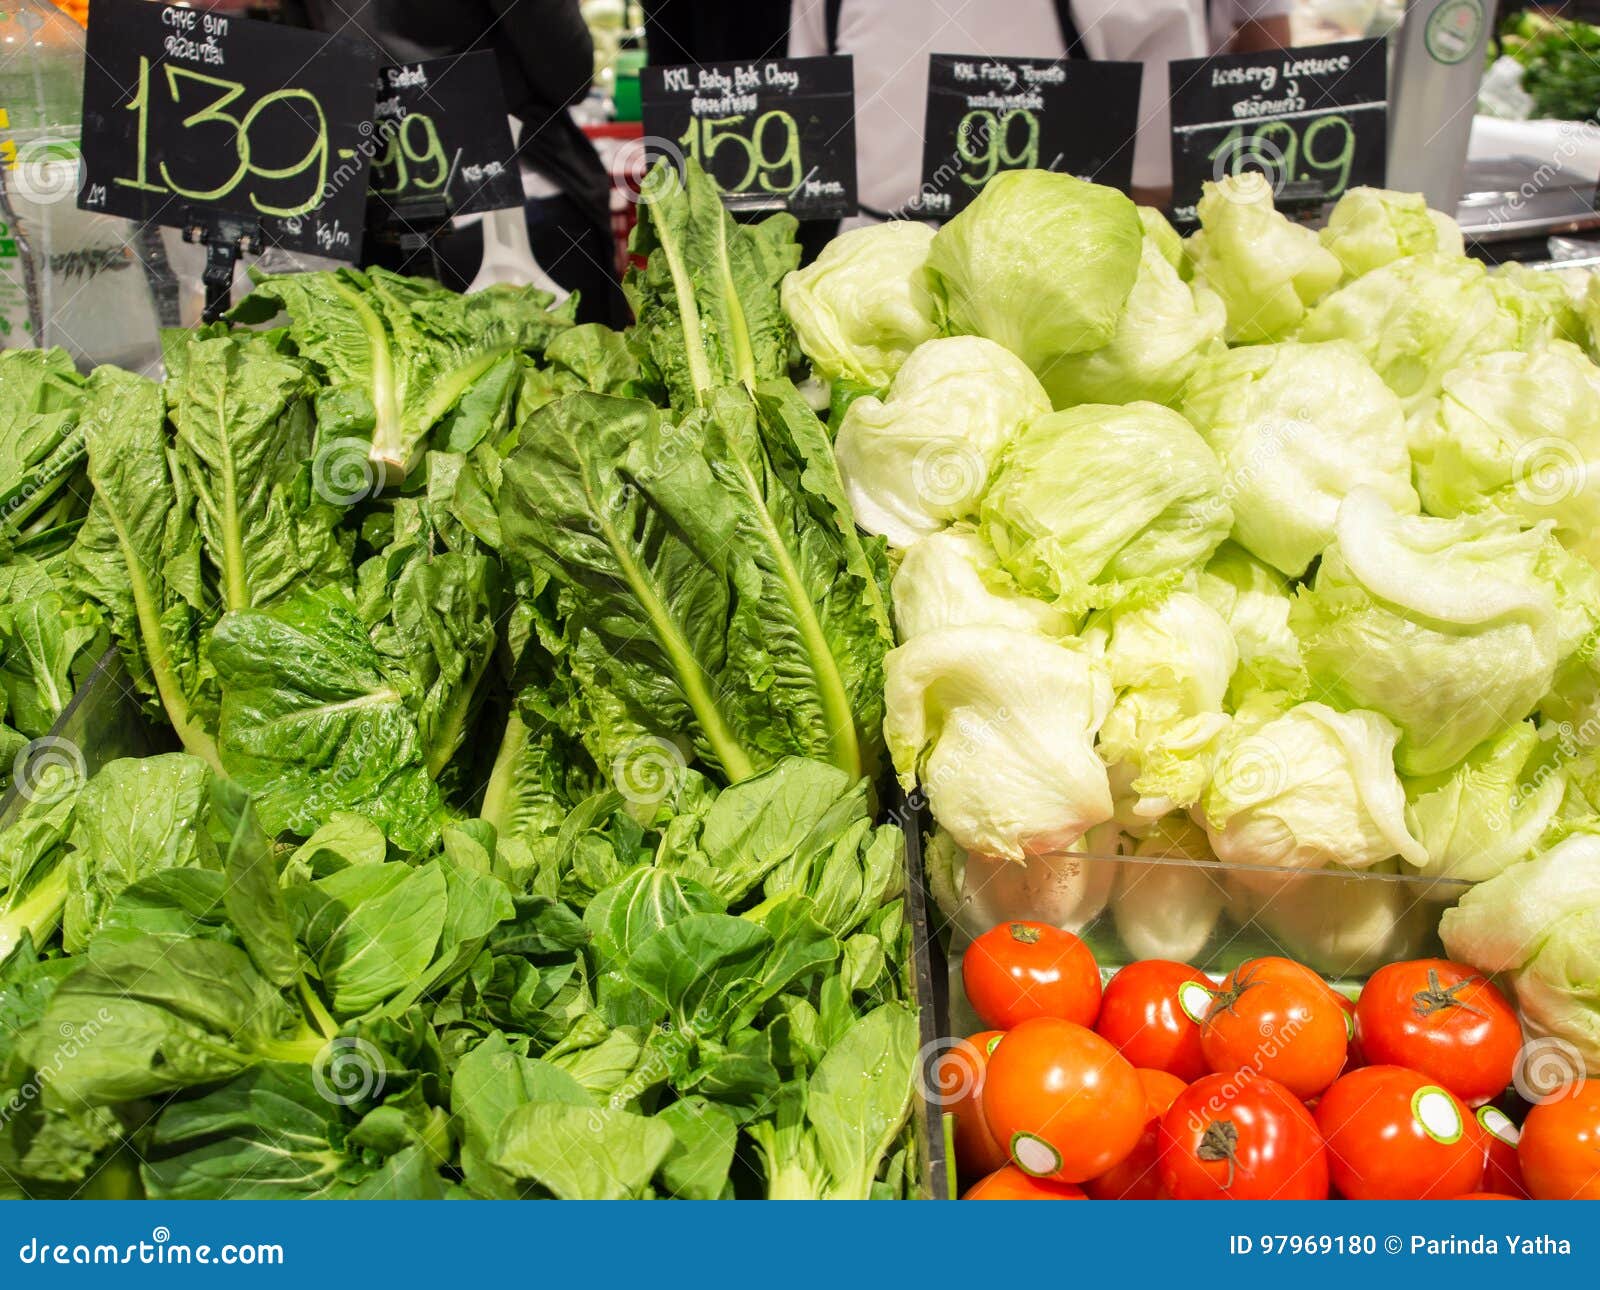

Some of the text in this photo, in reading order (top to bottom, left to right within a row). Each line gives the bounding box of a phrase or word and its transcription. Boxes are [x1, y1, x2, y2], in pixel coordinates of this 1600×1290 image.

[202, 14, 228, 37] SIM
[678, 110, 802, 193] 159
[956, 109, 1040, 186] 99
